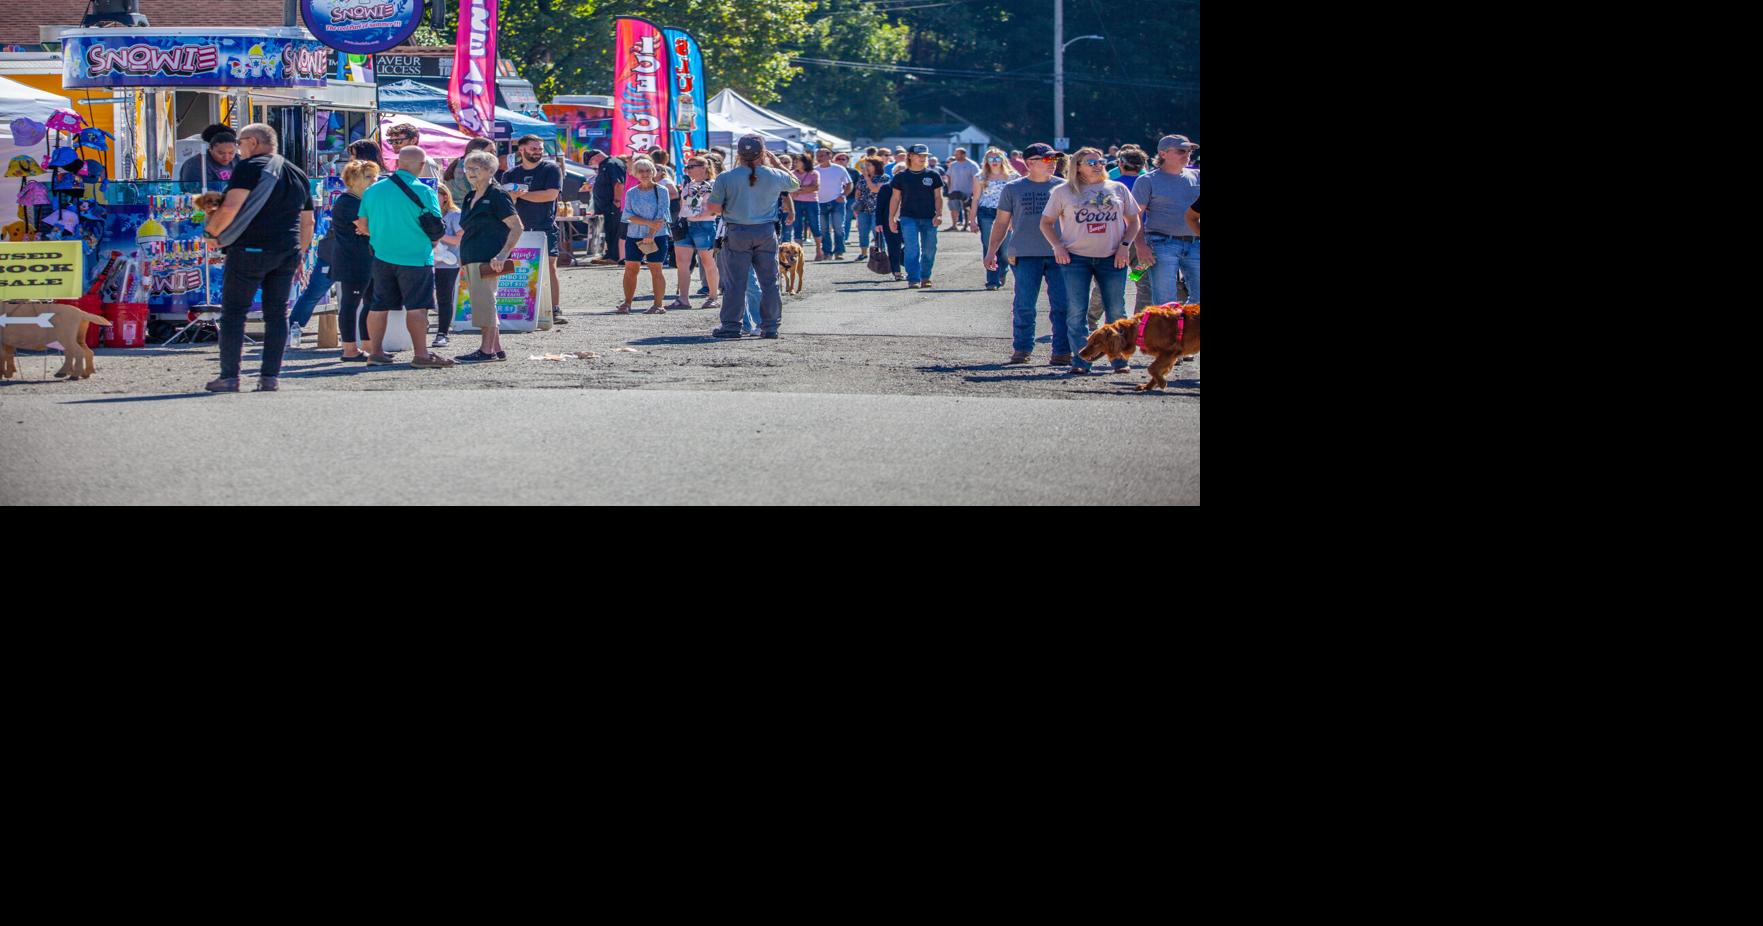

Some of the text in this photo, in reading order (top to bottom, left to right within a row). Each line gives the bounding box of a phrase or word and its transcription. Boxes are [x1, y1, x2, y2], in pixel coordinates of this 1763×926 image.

[331, 4, 395, 22] SNOWIE
[87, 44, 220, 77] SNOWIE
[377, 56, 421, 66] AVEUR
[377, 65, 421, 75] UCCESS
[1074, 208, 1118, 224] Coors
